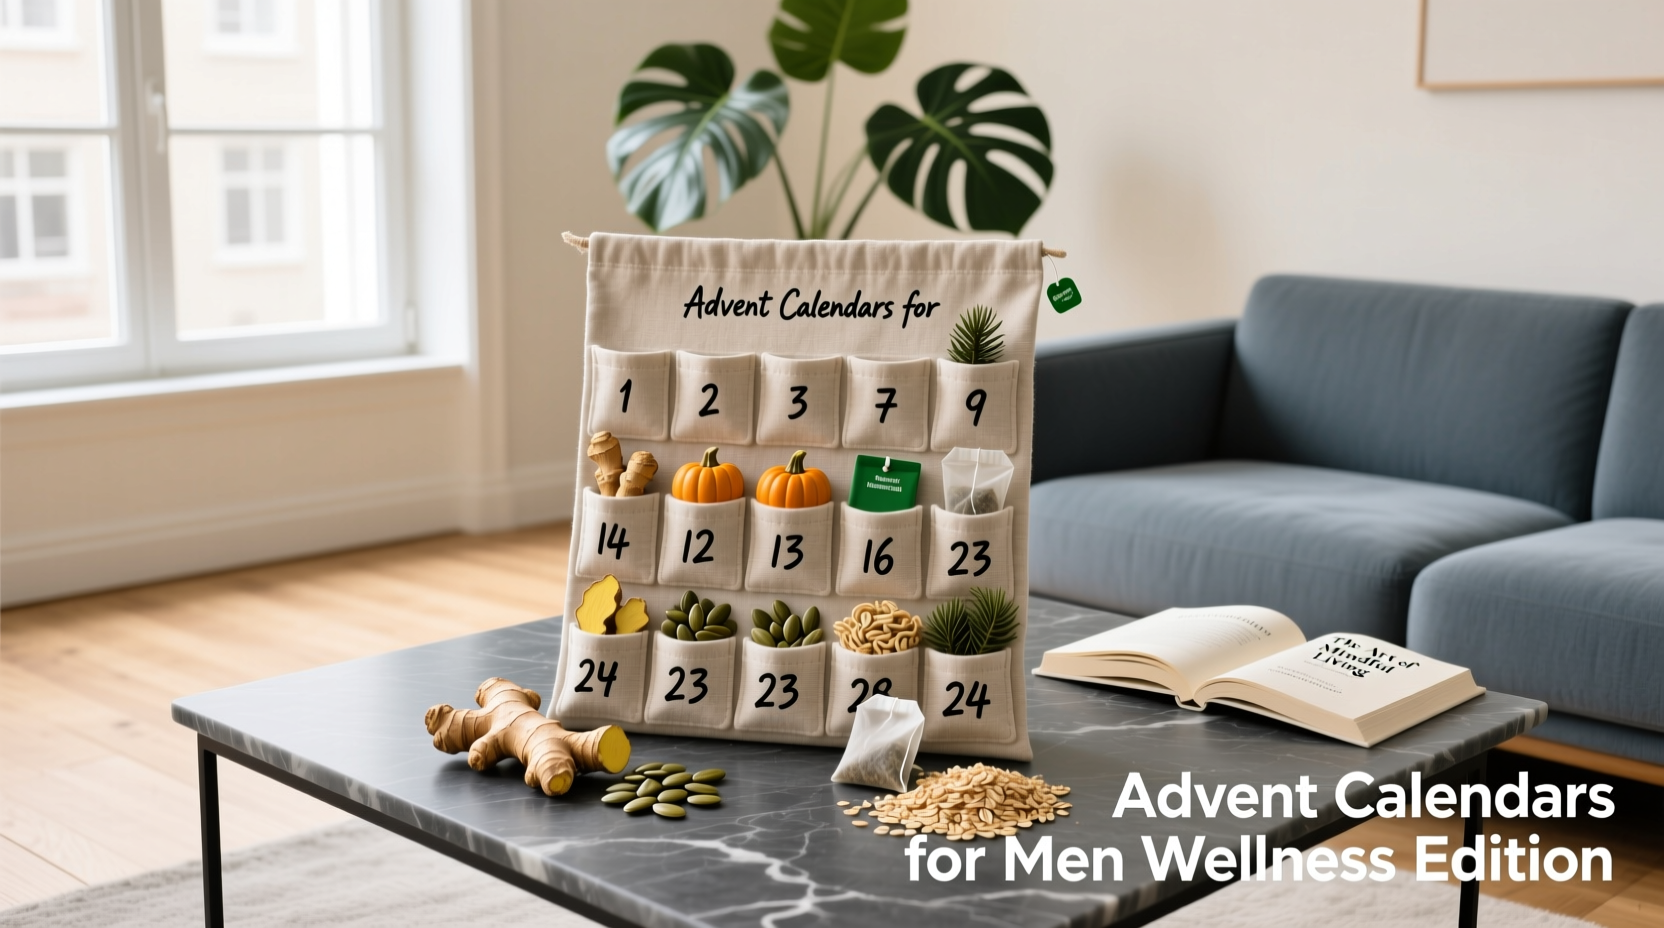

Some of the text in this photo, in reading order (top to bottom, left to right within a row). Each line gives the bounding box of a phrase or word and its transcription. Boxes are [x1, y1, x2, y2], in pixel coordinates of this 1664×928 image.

[683, 285, 941, 328] Advent Calendars for
[619, 378, 633, 414] 1
[698, 382, 721, 418] 2
[787, 385, 809, 420] 3
[875, 387, 898, 424] 7
[966, 389, 988, 427] 9
[597, 522, 631, 561] 14
[682, 528, 715, 564] 12
[771, 534, 804, 571] 13
[863, 536, 895, 576] 16
[947, 539, 992, 578] 23
[1313, 652, 1370, 677] Living
[1319, 643, 1395, 673] Mindful
[1364, 647, 1396, 662] Art
[574, 658, 619, 698] 24
[664, 666, 709, 705] 23
[754, 672, 800, 711] 23
[941, 680, 991, 720] 24
